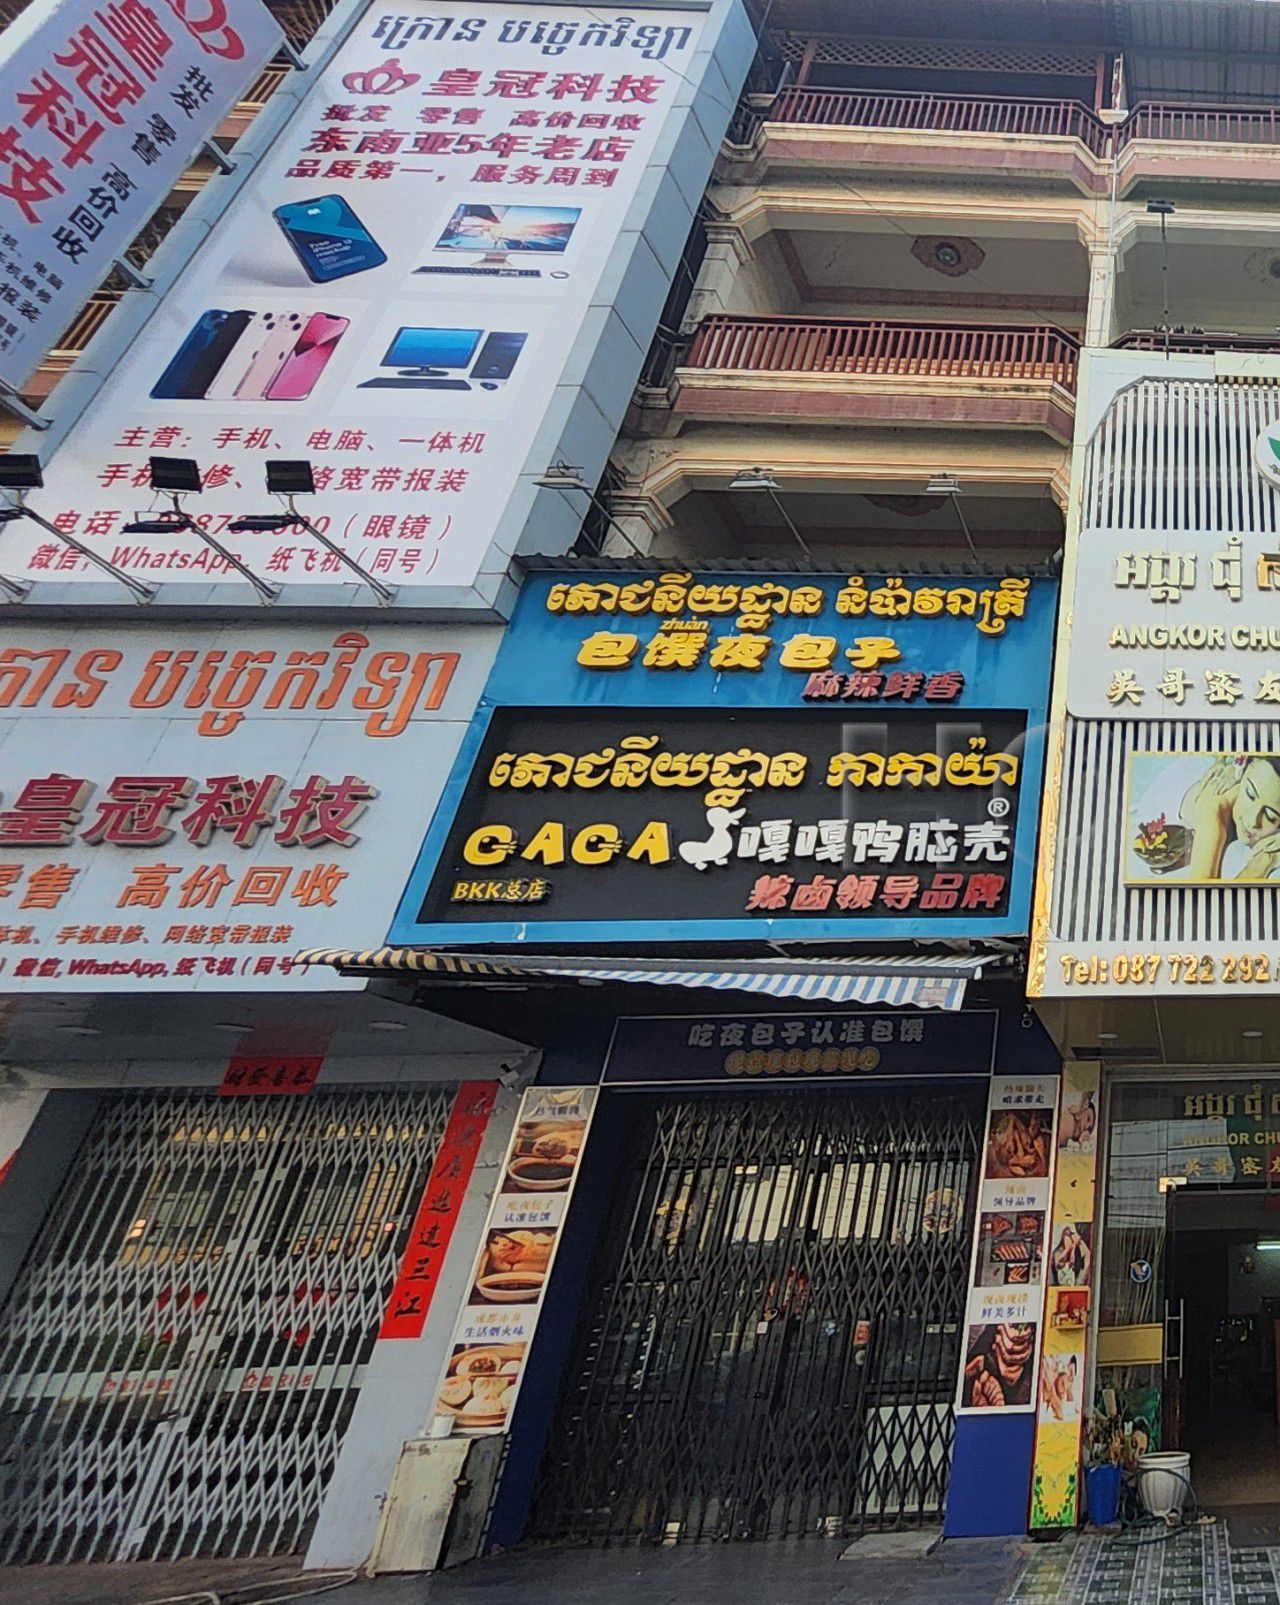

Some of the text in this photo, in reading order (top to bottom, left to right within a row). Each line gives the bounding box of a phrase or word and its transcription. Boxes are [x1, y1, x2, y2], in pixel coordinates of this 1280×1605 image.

[421, 68, 666, 104] 皇冠科技
[320, 104, 647, 131] 批发 零售 高价回收
[301, 127, 635, 162] 东南亚5年老店
[52, 65, 215, 264] 批发 零售 高价回收
[546, 572, 823, 632] ភោជនីយដ្ឋាន
[1109, 624, 1226, 650] ANGKOR
[801, 669, 966, 702] 麻辣鲜香
[489, 735, 807, 809] ភោជនីយដ្ឋាន
[0, 773, 374, 849] 皇冠科技
[738, 819, 1010, 864] 嘎嘎鸭脑壳
[116, 863, 350, 910] 高价回收
[744, 873, 1007, 913] 辣卤领导品牌
[1060, 954, 1108, 985] Tel:
[1167, 953, 1214, 985] 722
[1221, 953, 1271, 984] 292
[687, 1018, 924, 1047] 吃夜包子认准包馔
